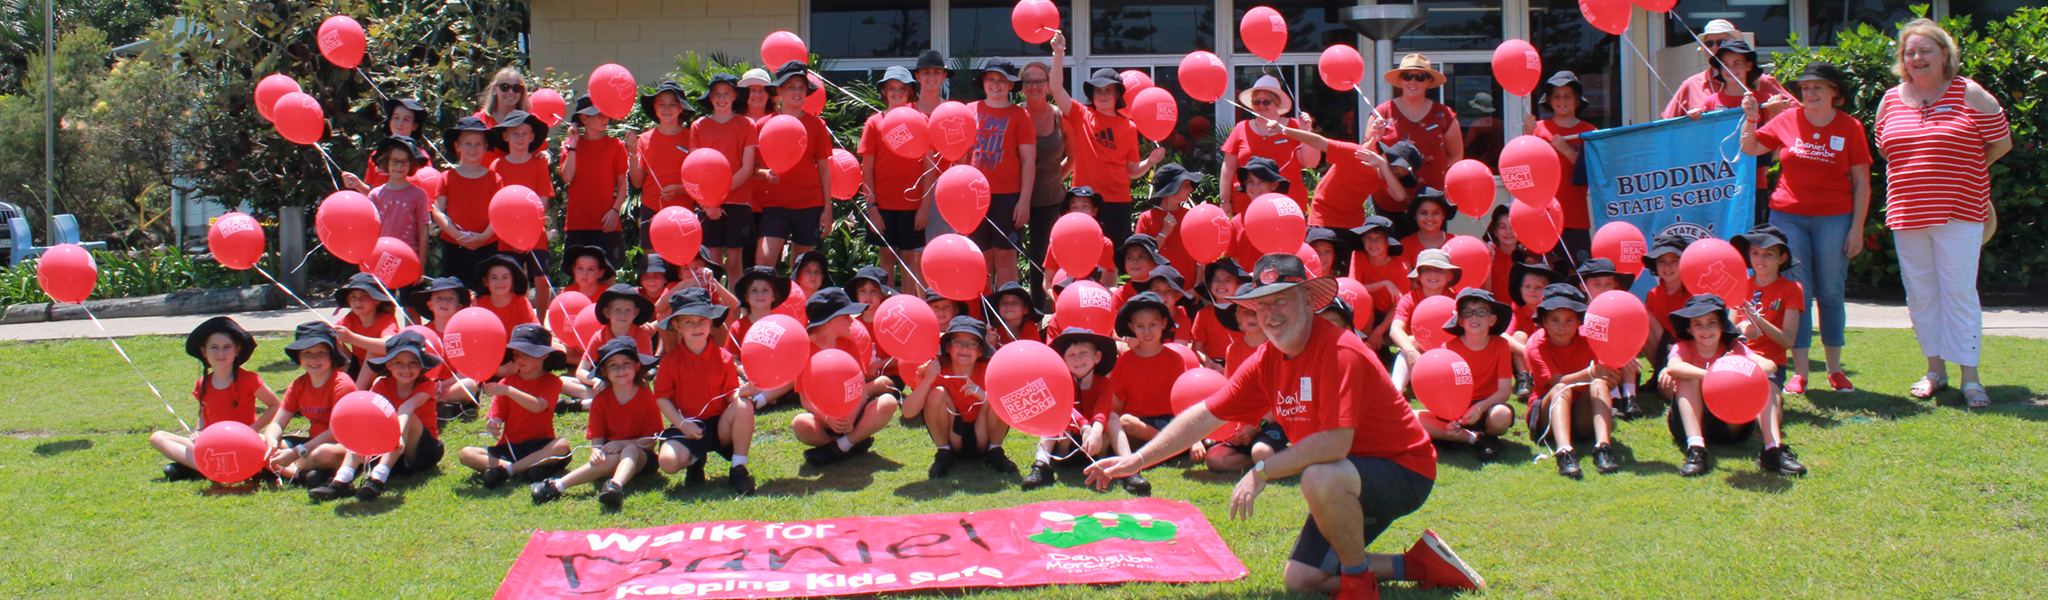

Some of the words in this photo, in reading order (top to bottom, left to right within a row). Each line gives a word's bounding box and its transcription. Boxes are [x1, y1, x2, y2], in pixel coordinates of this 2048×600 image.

[1789, 146, 1835, 158] Morcombe
[1795, 138, 1826, 151] Daniel
[1615, 159, 1736, 196] BUDDINA
[1606, 196, 1664, 217] STATE
[1670, 183, 1735, 209] SCHOO
[1666, 226, 1697, 236] STATE
[1082, 292, 1110, 303] REACT
[1082, 300, 1110, 311] REPORT
[745, 334, 777, 347] REPORT
[749, 326, 780, 339] REACT
[1002, 379, 1045, 405] RECOGNISE
[1006, 387, 1048, 414] REACT
[1012, 397, 1054, 422] REPORT
[586, 524, 747, 552] Walk
[765, 523, 836, 539] for
[545, 518, 991, 594] Daniel
[615, 578, 791, 599] Keeping
[806, 572, 898, 590] Kids
[909, 564, 1004, 584] Safe
